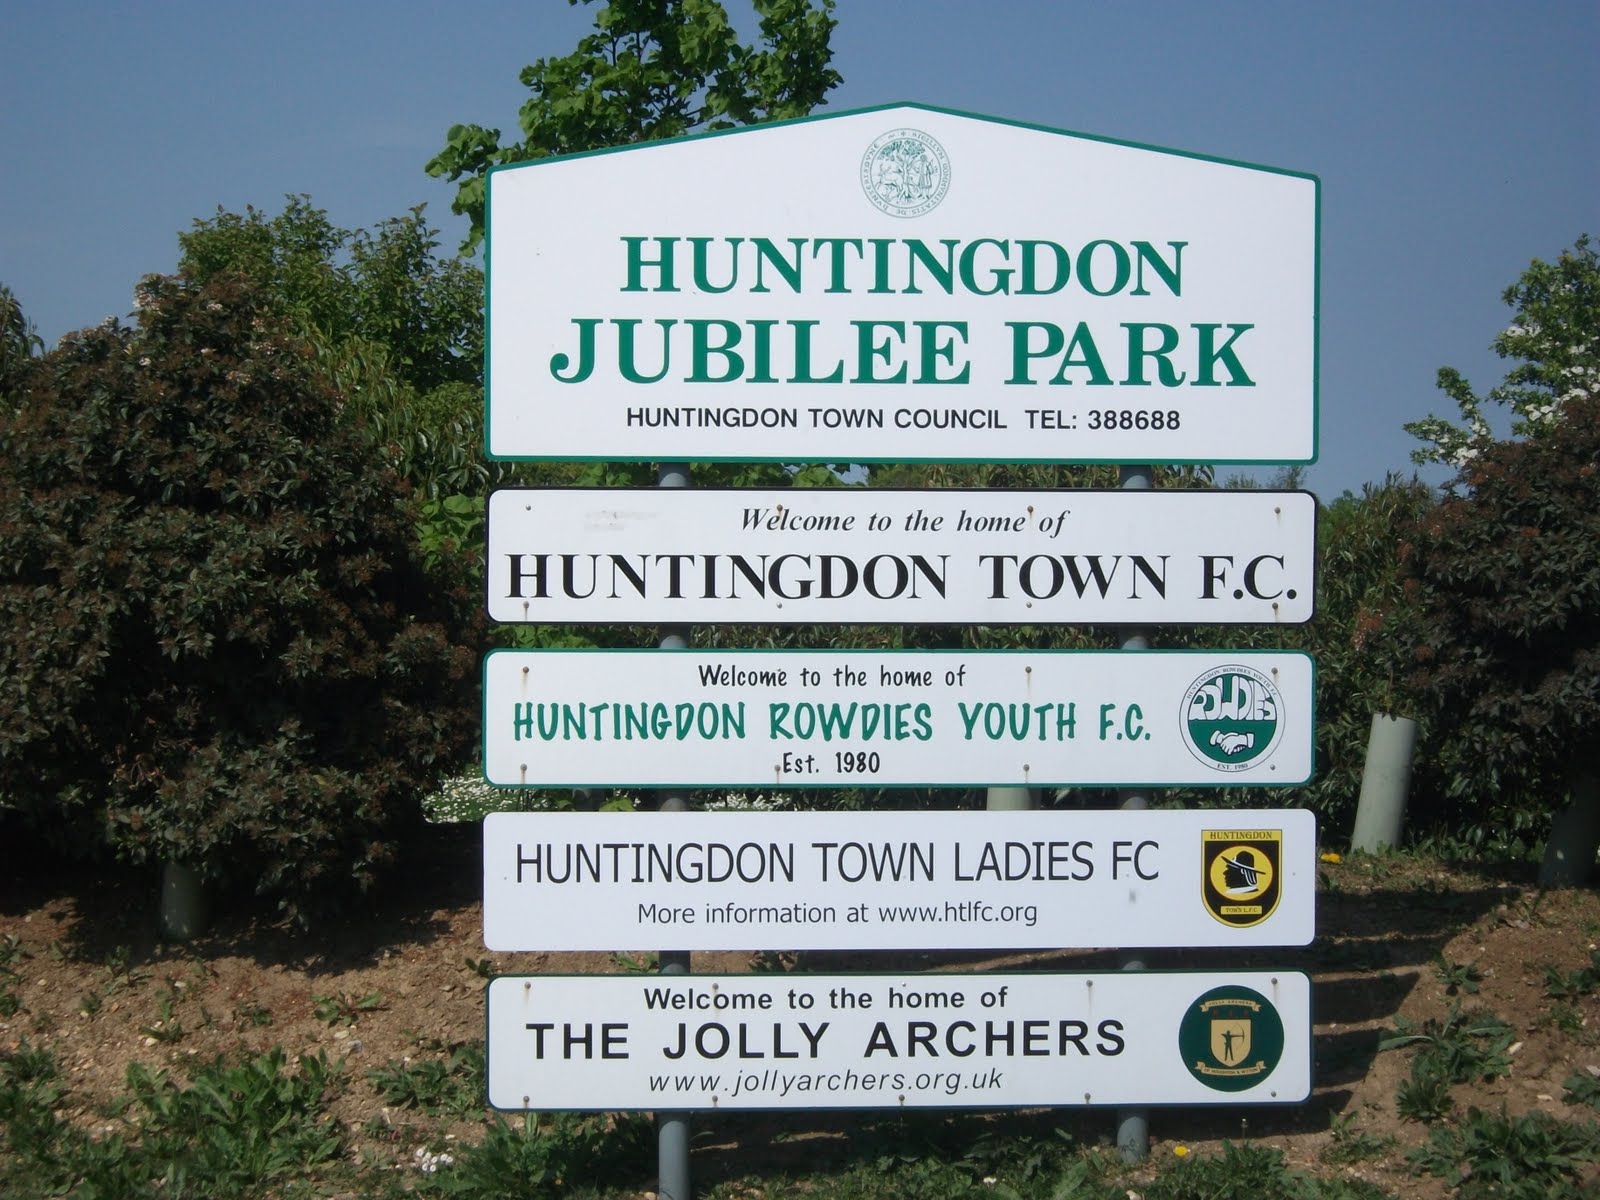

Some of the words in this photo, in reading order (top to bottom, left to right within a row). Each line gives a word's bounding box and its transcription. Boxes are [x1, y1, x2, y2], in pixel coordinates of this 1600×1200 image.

[619, 236, 1189, 297] HUNTINGDON
[549, 318, 971, 385] JUBILEE
[1003, 321, 1257, 388] PARK
[627, 407, 798, 428] HUNTINGDON
[807, 408, 883, 429] TOWN
[894, 408, 1008, 430] COUNCIL
[1024, 409, 1078, 430] TEL:
[1087, 409, 1181, 431] 388688
[742, 507, 856, 532] Welcome
[868, 513, 892, 532] to
[904, 509, 944, 532] the
[956, 509, 1026, 532] home
[1037, 510, 1068, 539] of
[507, 553, 951, 600] HUNTINGDON
[978, 554, 1171, 600] TOWN
[1198, 554, 1298, 600] F.C.
[698, 663, 788, 687] Welcome
[799, 667, 821, 687] to
[832, 664, 867, 687] the
[880, 664, 933, 687] home
[945, 663, 966, 687] of
[513, 701, 746, 742] HUNTINGDON
[768, 701, 933, 742] ROWDIES
[957, 702, 1077, 742] YOUTH
[1099, 702, 1152, 742] F.C.
[783, 751, 820, 774] Est.
[835, 751, 881, 774] 1980
[1210, 831, 1273, 840] HUNTINGDON
[516, 842, 794, 884] HUNTINGDON
[811, 841, 934, 883] TOWN
[954, 840, 1094, 882] LADIES
[1112, 840, 1160, 882] FC
[638, 903, 695, 924] More
[706, 902, 836, 924] information
[846, 903, 869, 924] at
[878, 900, 1037, 927] www.htlfc.org
[643, 988, 773, 1010] Welcome
[787, 988, 815, 1010] to
[828, 987, 873, 1010] the
[888, 987, 965, 1009] home
[980, 985, 1009, 1009] of
[525, 1022, 630, 1060] THE
[662, 1022, 830, 1060] JOLLY
[863, 1019, 1125, 1059] ARCHERS
[649, 1067, 1004, 1098] www.jollyarchers.org.uk
